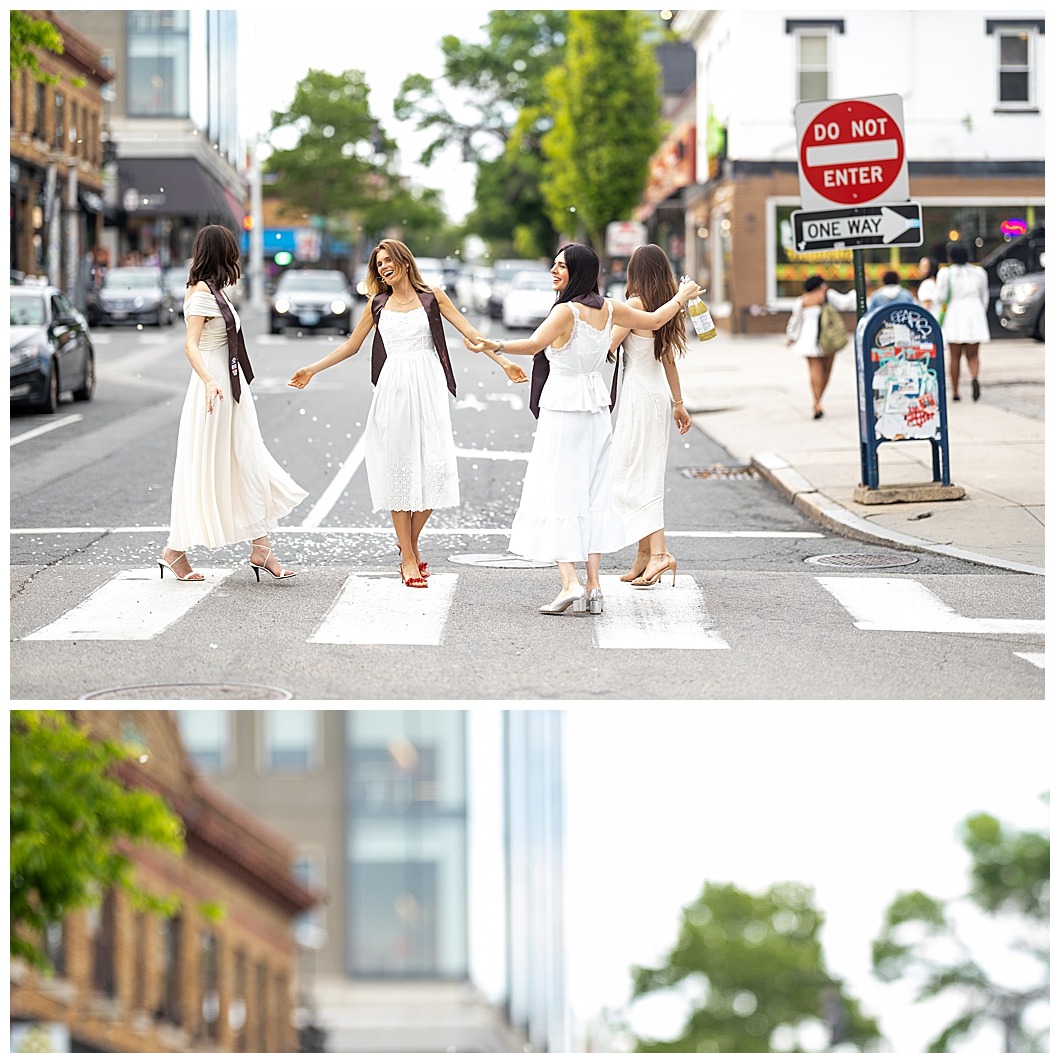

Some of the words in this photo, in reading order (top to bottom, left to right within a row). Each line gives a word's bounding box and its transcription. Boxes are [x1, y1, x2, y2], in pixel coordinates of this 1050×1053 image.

[814, 122, 840, 141] DO
[851, 118, 887, 138] NOT
[823, 165, 883, 188] ENTER
[807, 221, 841, 238] ONE
[848, 218, 882, 235] WAY
